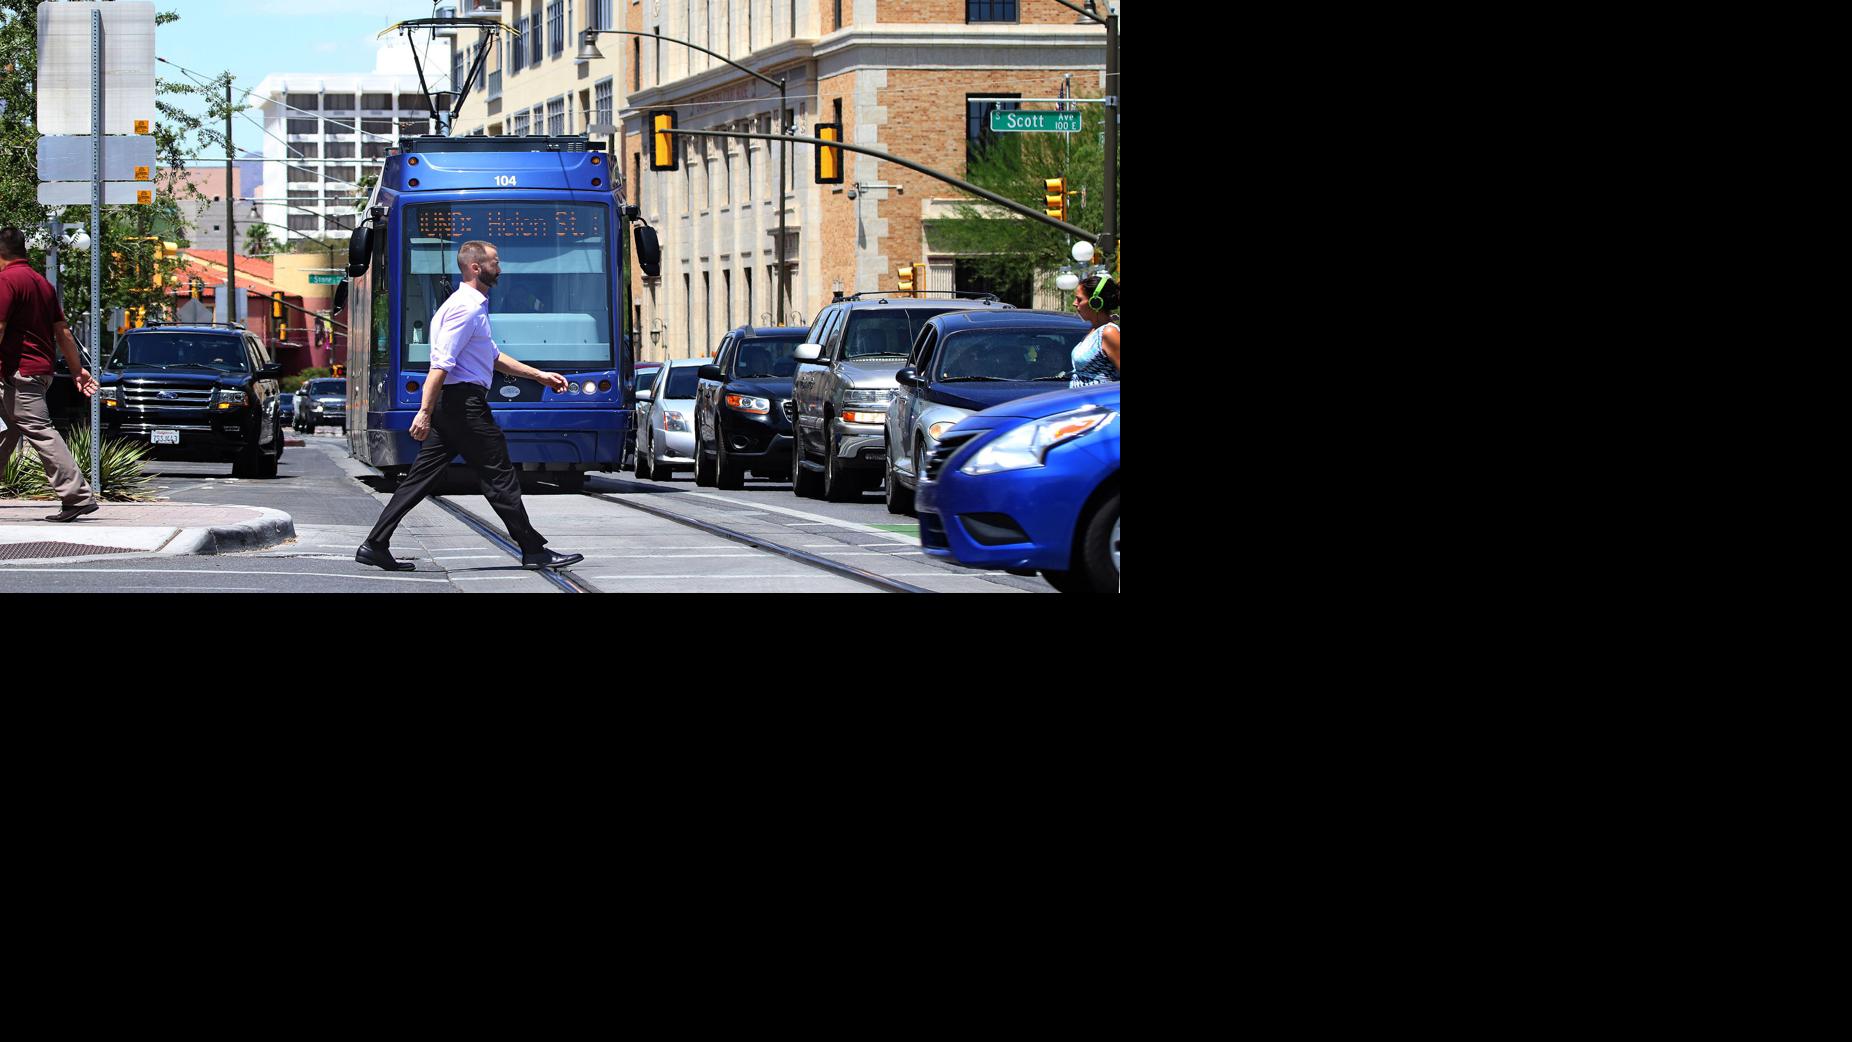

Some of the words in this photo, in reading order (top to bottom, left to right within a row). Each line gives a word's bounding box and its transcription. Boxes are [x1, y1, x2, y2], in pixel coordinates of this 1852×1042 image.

[995, 112, 1001, 120] S
[1007, 113, 1044, 128] Scott
[1058, 113, 1074, 121] Ave
[1055, 121, 1069, 130] 100
[1071, 121, 1077, 130] E
[494, 175, 517, 186] 104
[488, 211, 547, 237] Helen
